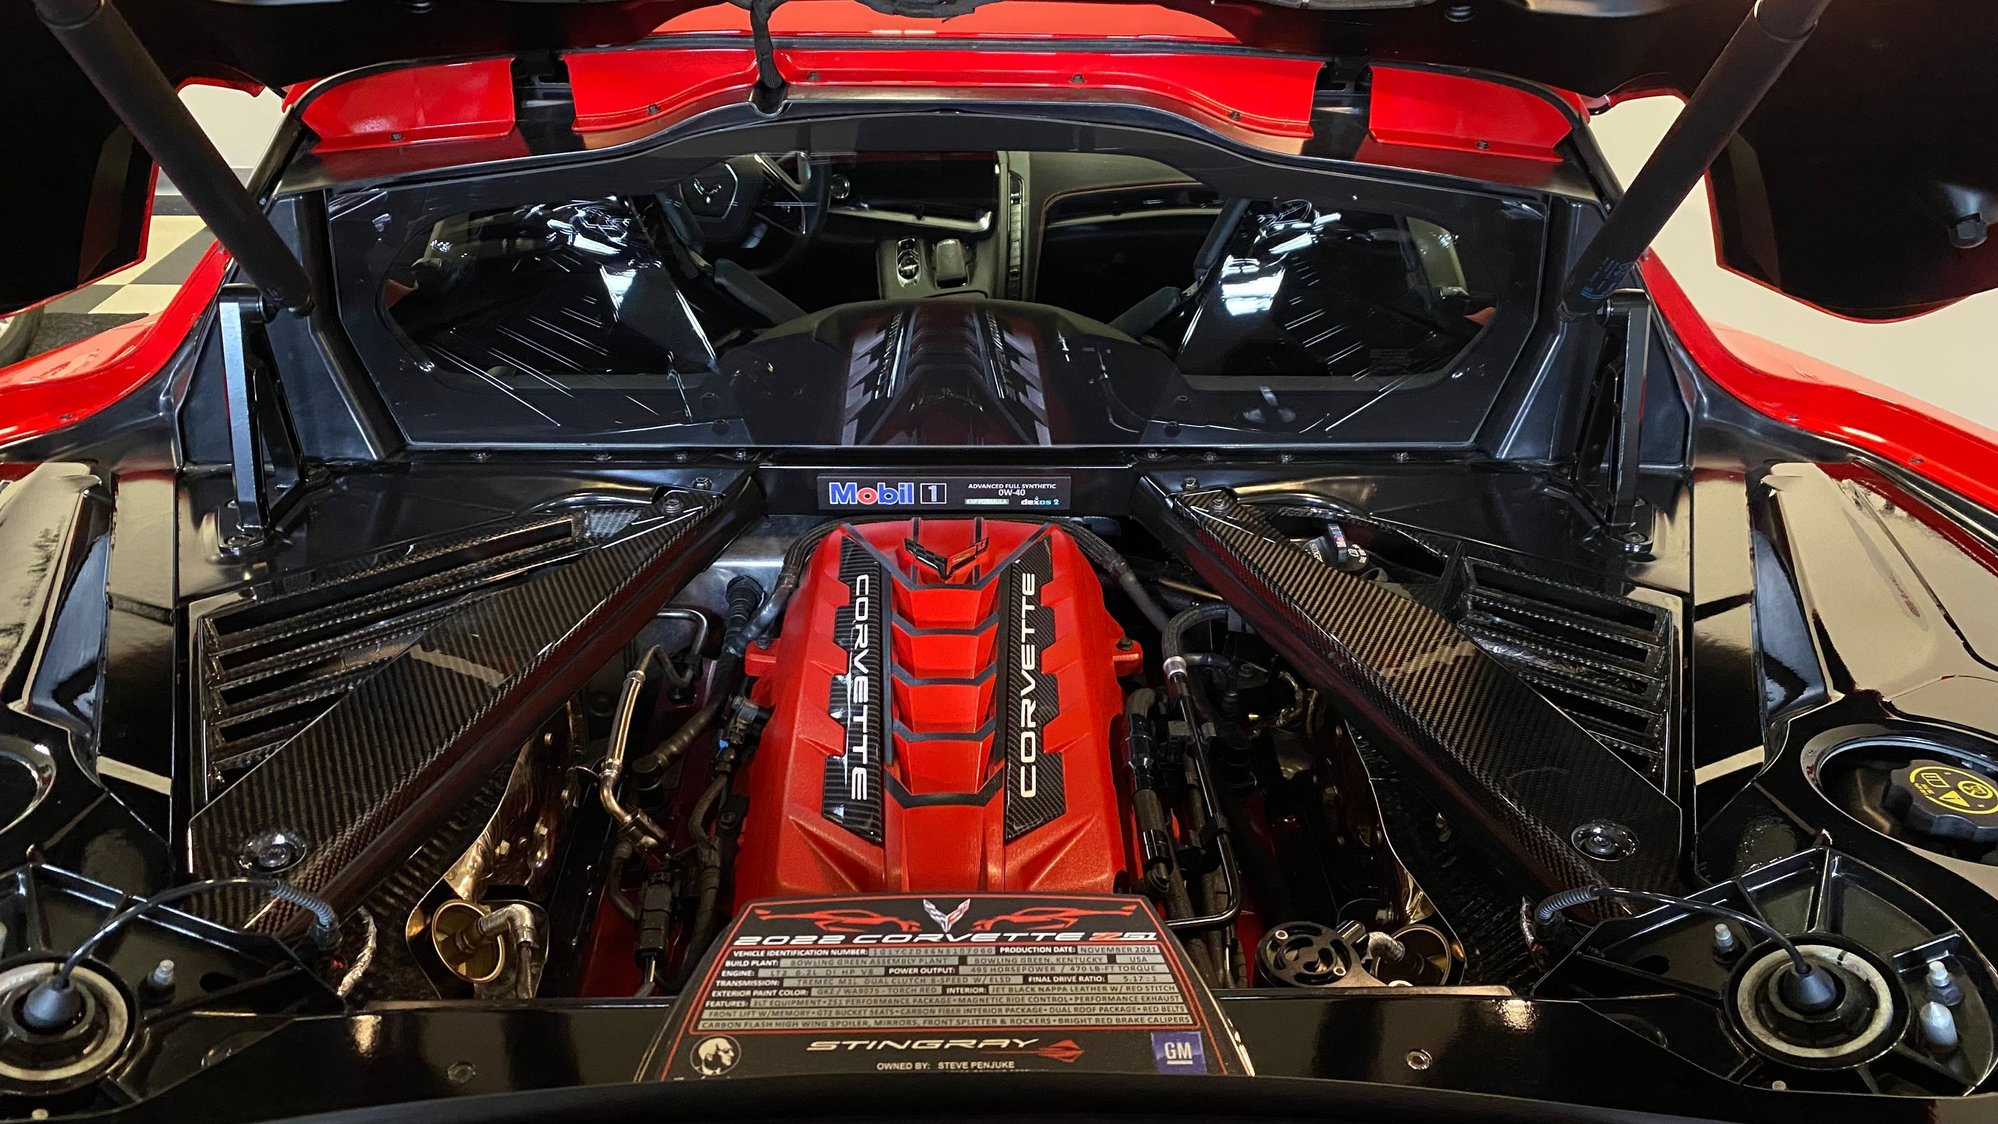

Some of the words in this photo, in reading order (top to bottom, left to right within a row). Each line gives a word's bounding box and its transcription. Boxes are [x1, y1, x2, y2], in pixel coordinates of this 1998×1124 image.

[829, 482, 914, 504] Mobil
[851, 573, 870, 801] CORVETTE
[1020, 572, 1036, 798] CORVETTE
[733, 935, 846, 946] 2022
[852, 933, 1085, 943] CORVETTE
[1089, 932, 1157, 940] Z51
[845, 997, 908, 1005] PERFORMANCE
[806, 1038, 1040, 1051] STINGRAY
[1164, 1041, 1193, 1060] GM
[877, 1062, 912, 1070] OWNED
[915, 1062, 931, 1070] BY:
[971, 1061, 1015, 1069] PENJUKE
